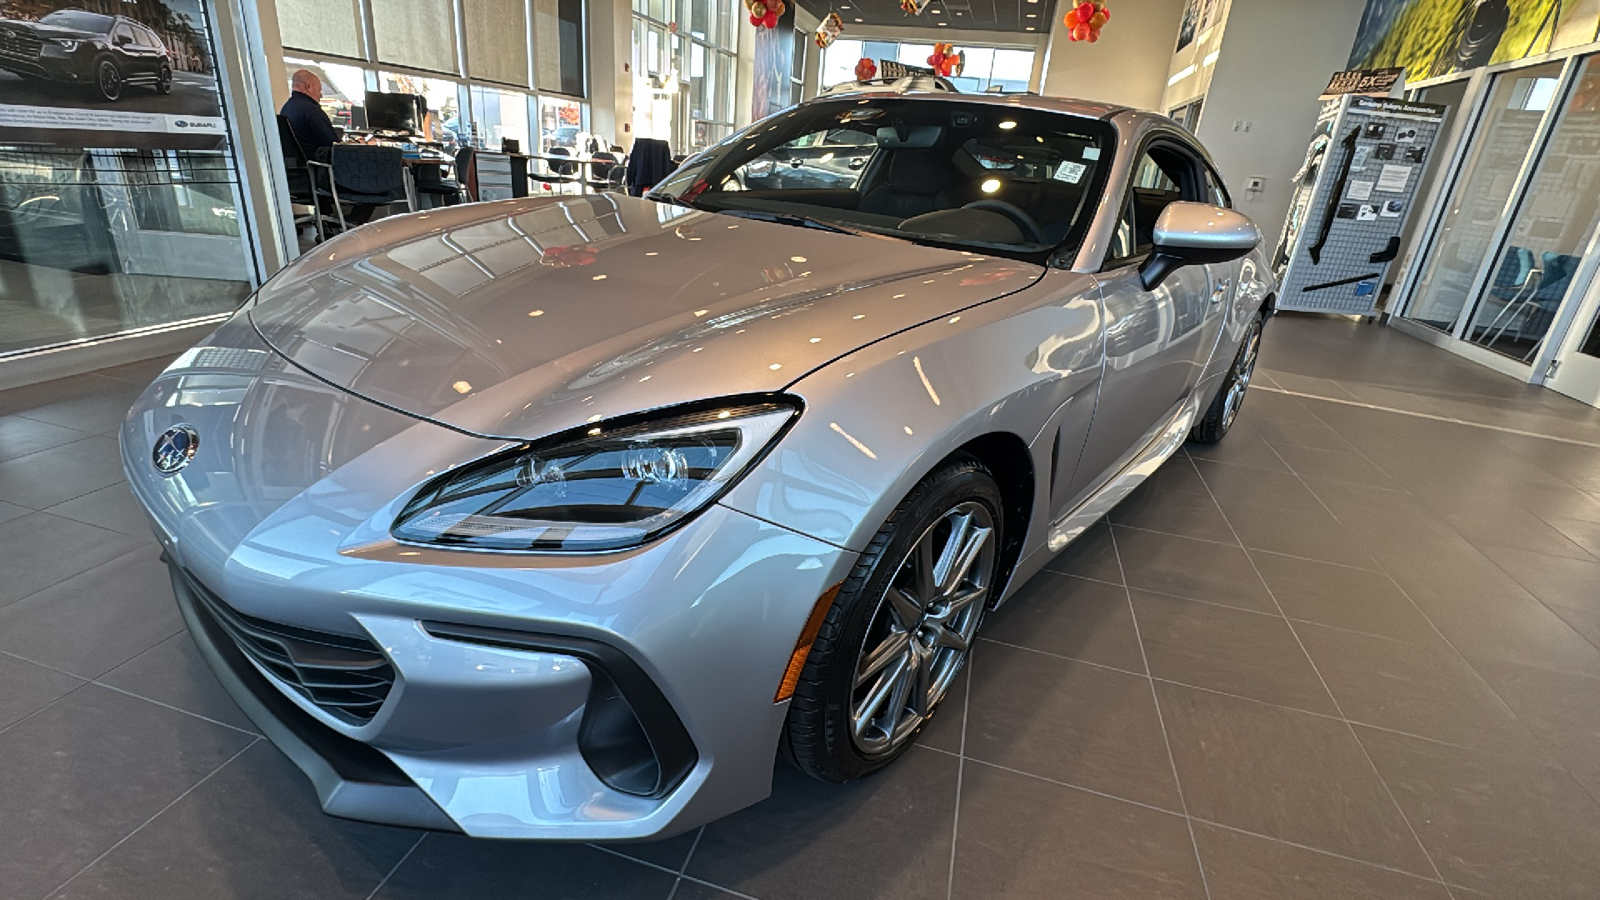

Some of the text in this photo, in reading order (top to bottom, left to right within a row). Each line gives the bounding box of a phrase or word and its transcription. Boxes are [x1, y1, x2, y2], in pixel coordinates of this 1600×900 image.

[1358, 100, 1436, 114] Genuine Subaru Accessories
